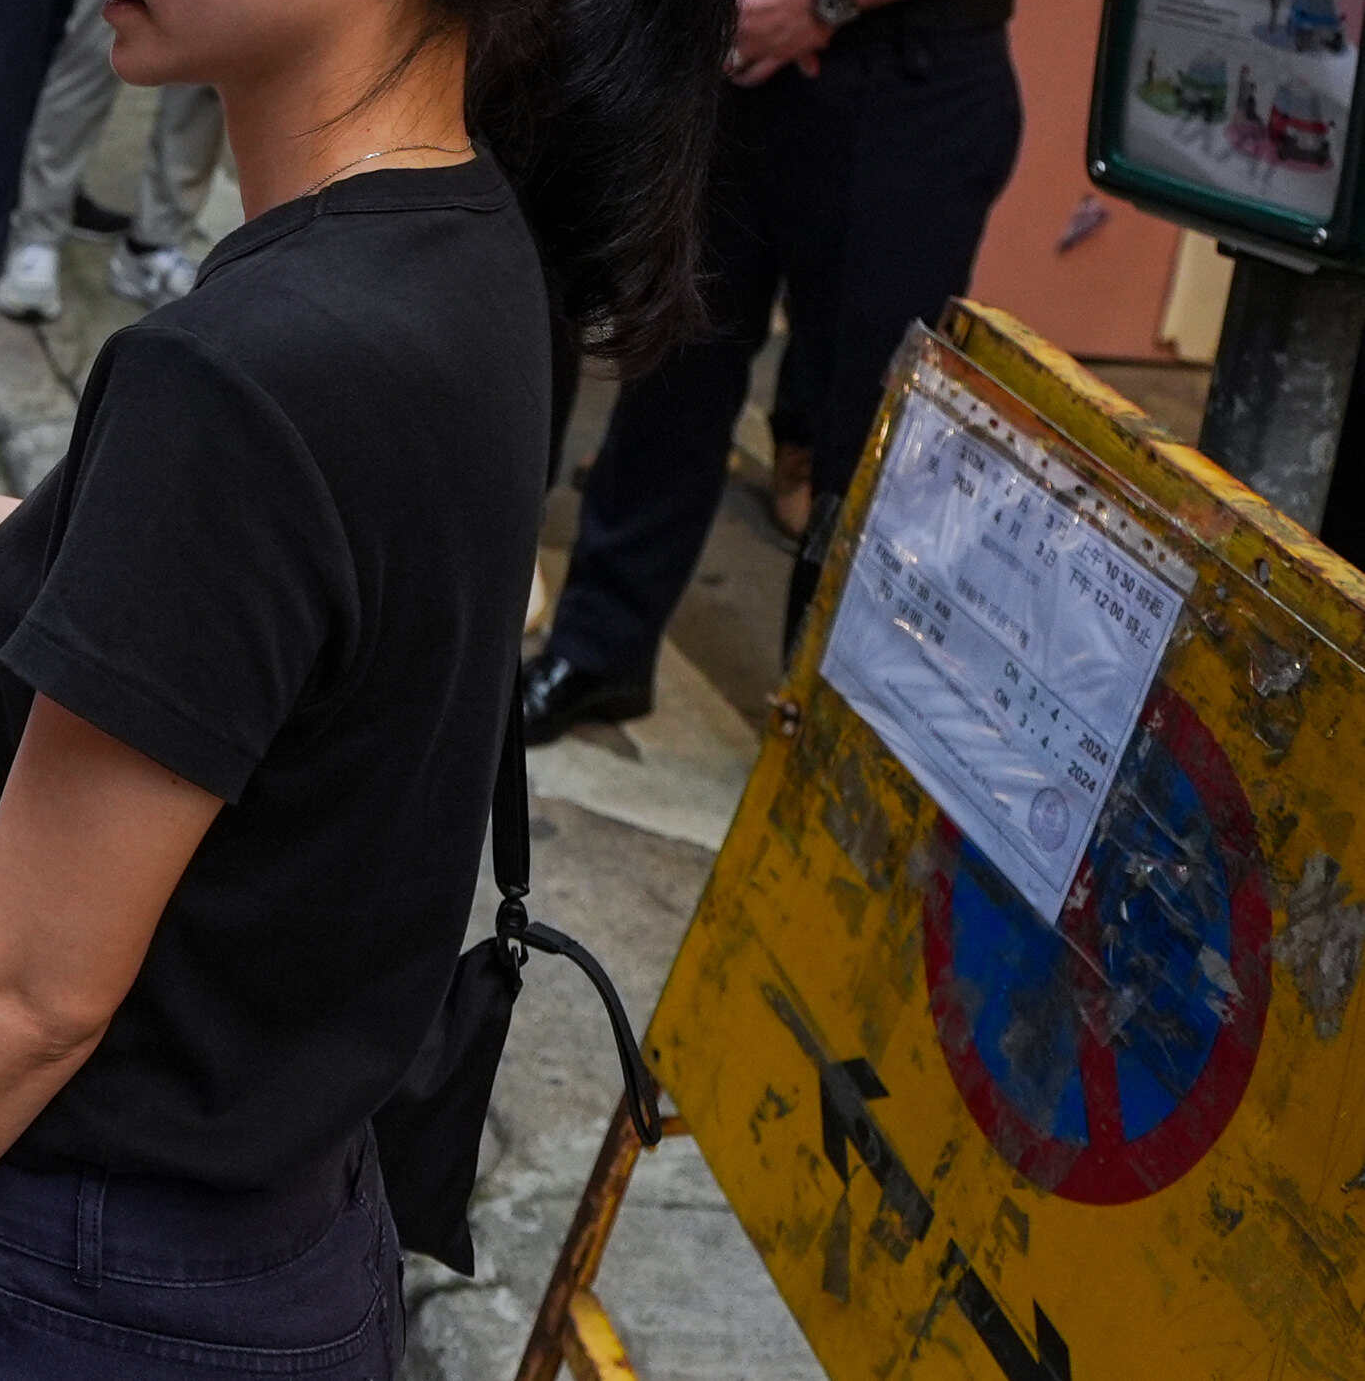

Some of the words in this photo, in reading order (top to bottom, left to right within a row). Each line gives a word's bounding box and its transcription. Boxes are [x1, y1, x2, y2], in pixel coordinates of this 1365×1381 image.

[995, 687, 1011, 713] ON
[1067, 759, 1097, 794] 2024
[1004, 660, 1020, 686] ON
[1078, 731, 1108, 767] 2024
